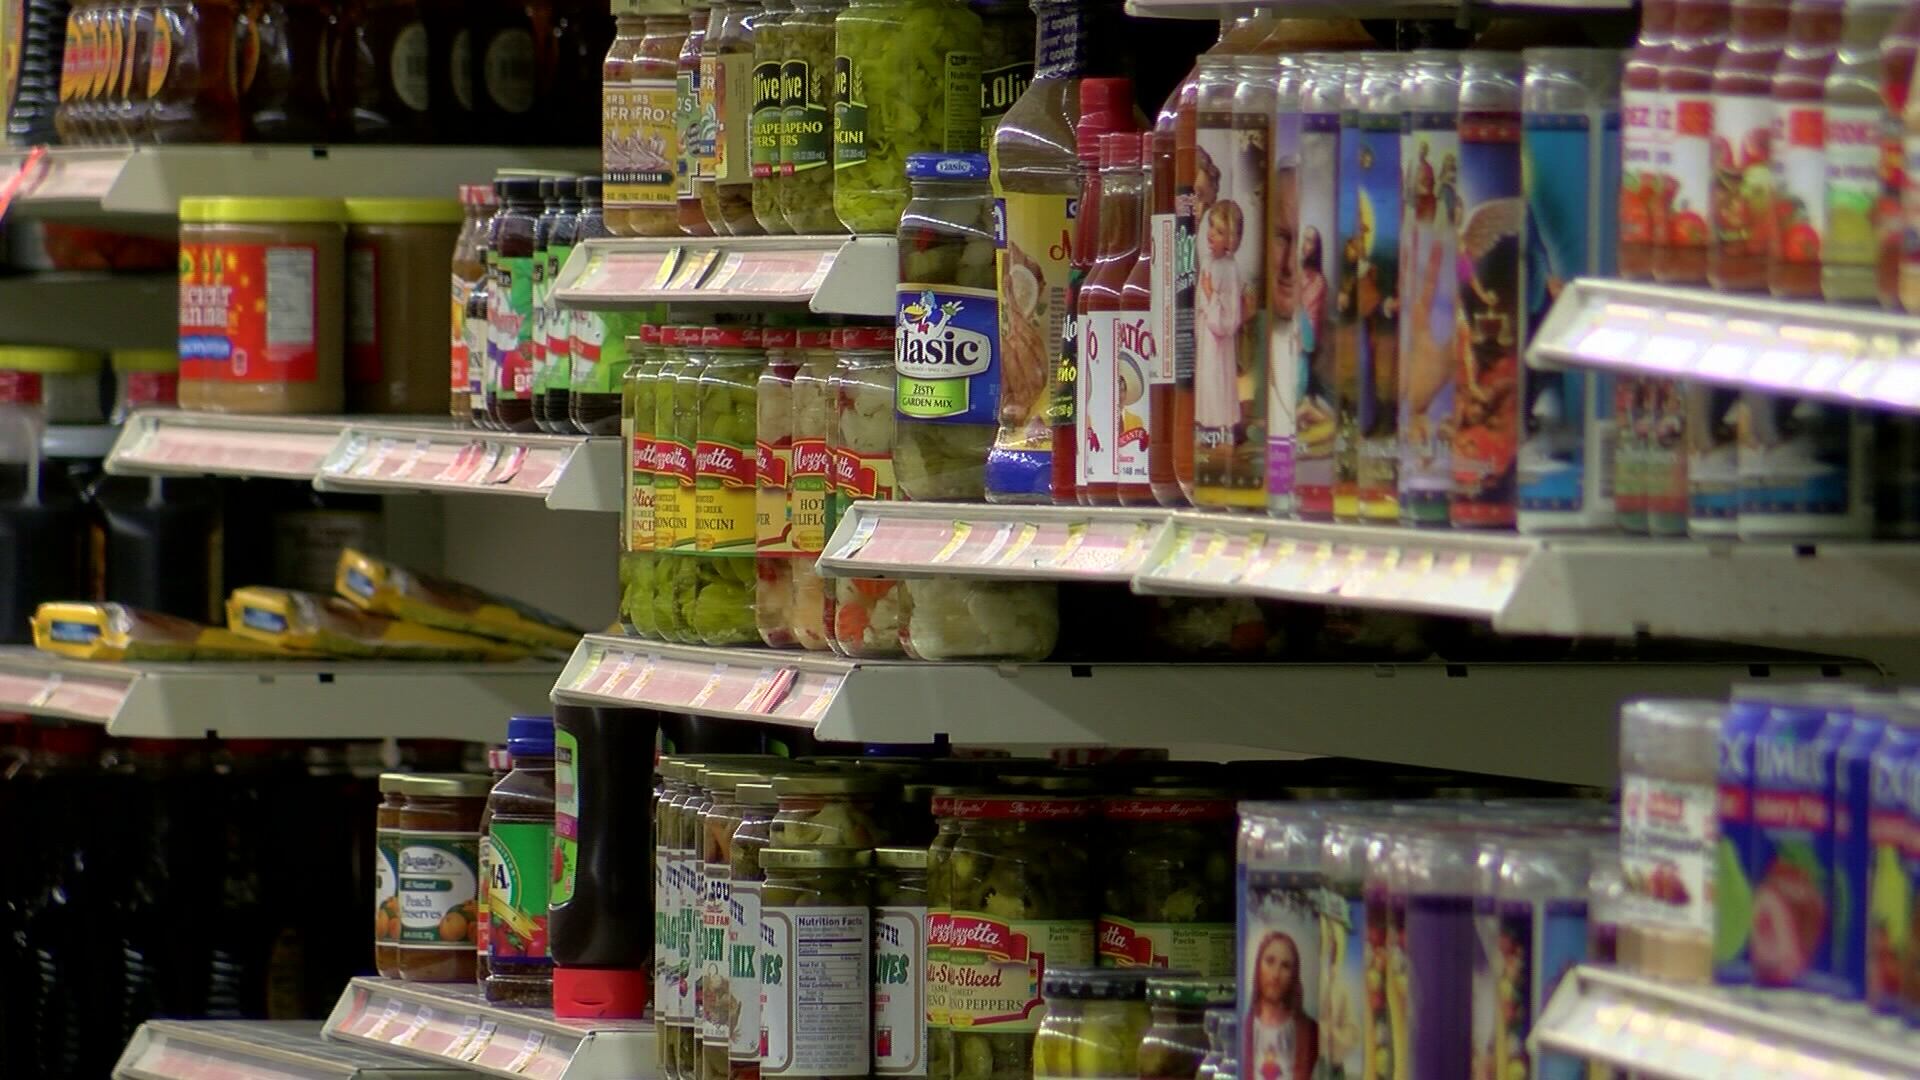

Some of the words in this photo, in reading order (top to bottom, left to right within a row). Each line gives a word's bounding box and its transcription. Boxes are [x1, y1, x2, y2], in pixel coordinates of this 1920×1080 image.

[913, 383, 936, 396] ZESTY
[902, 397, 932, 408] GARDEN
[933, 399, 953, 409] MIX
[799, 917, 840, 927] Nutrition
[842, 916, 864, 926] Facts
[965, 999, 1024, 1011] PEPPERS
